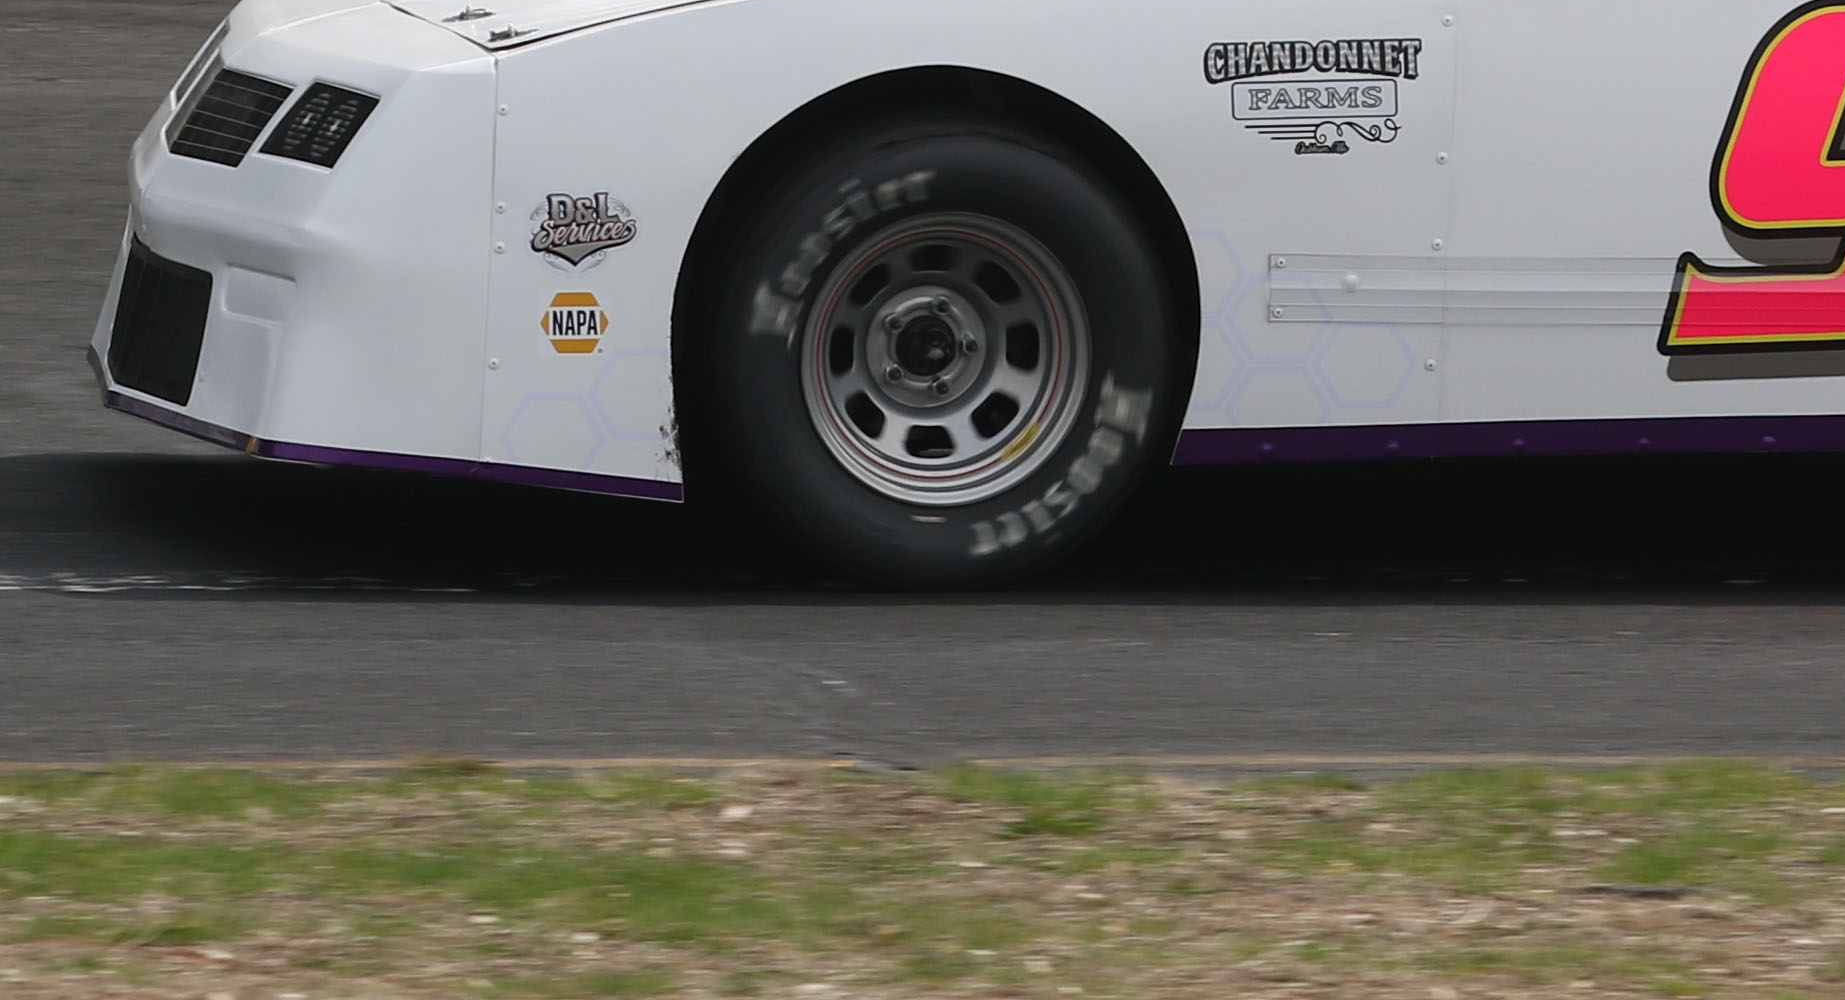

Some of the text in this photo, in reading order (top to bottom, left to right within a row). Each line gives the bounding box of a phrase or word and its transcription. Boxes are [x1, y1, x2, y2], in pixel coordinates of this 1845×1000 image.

[1203, 38, 1422, 84] CHANDONNET
[1248, 86, 1383, 110] FARMS
[546, 191, 621, 225] D&L
[530, 218, 637, 252] Services
[551, 309, 599, 336] NAPA
